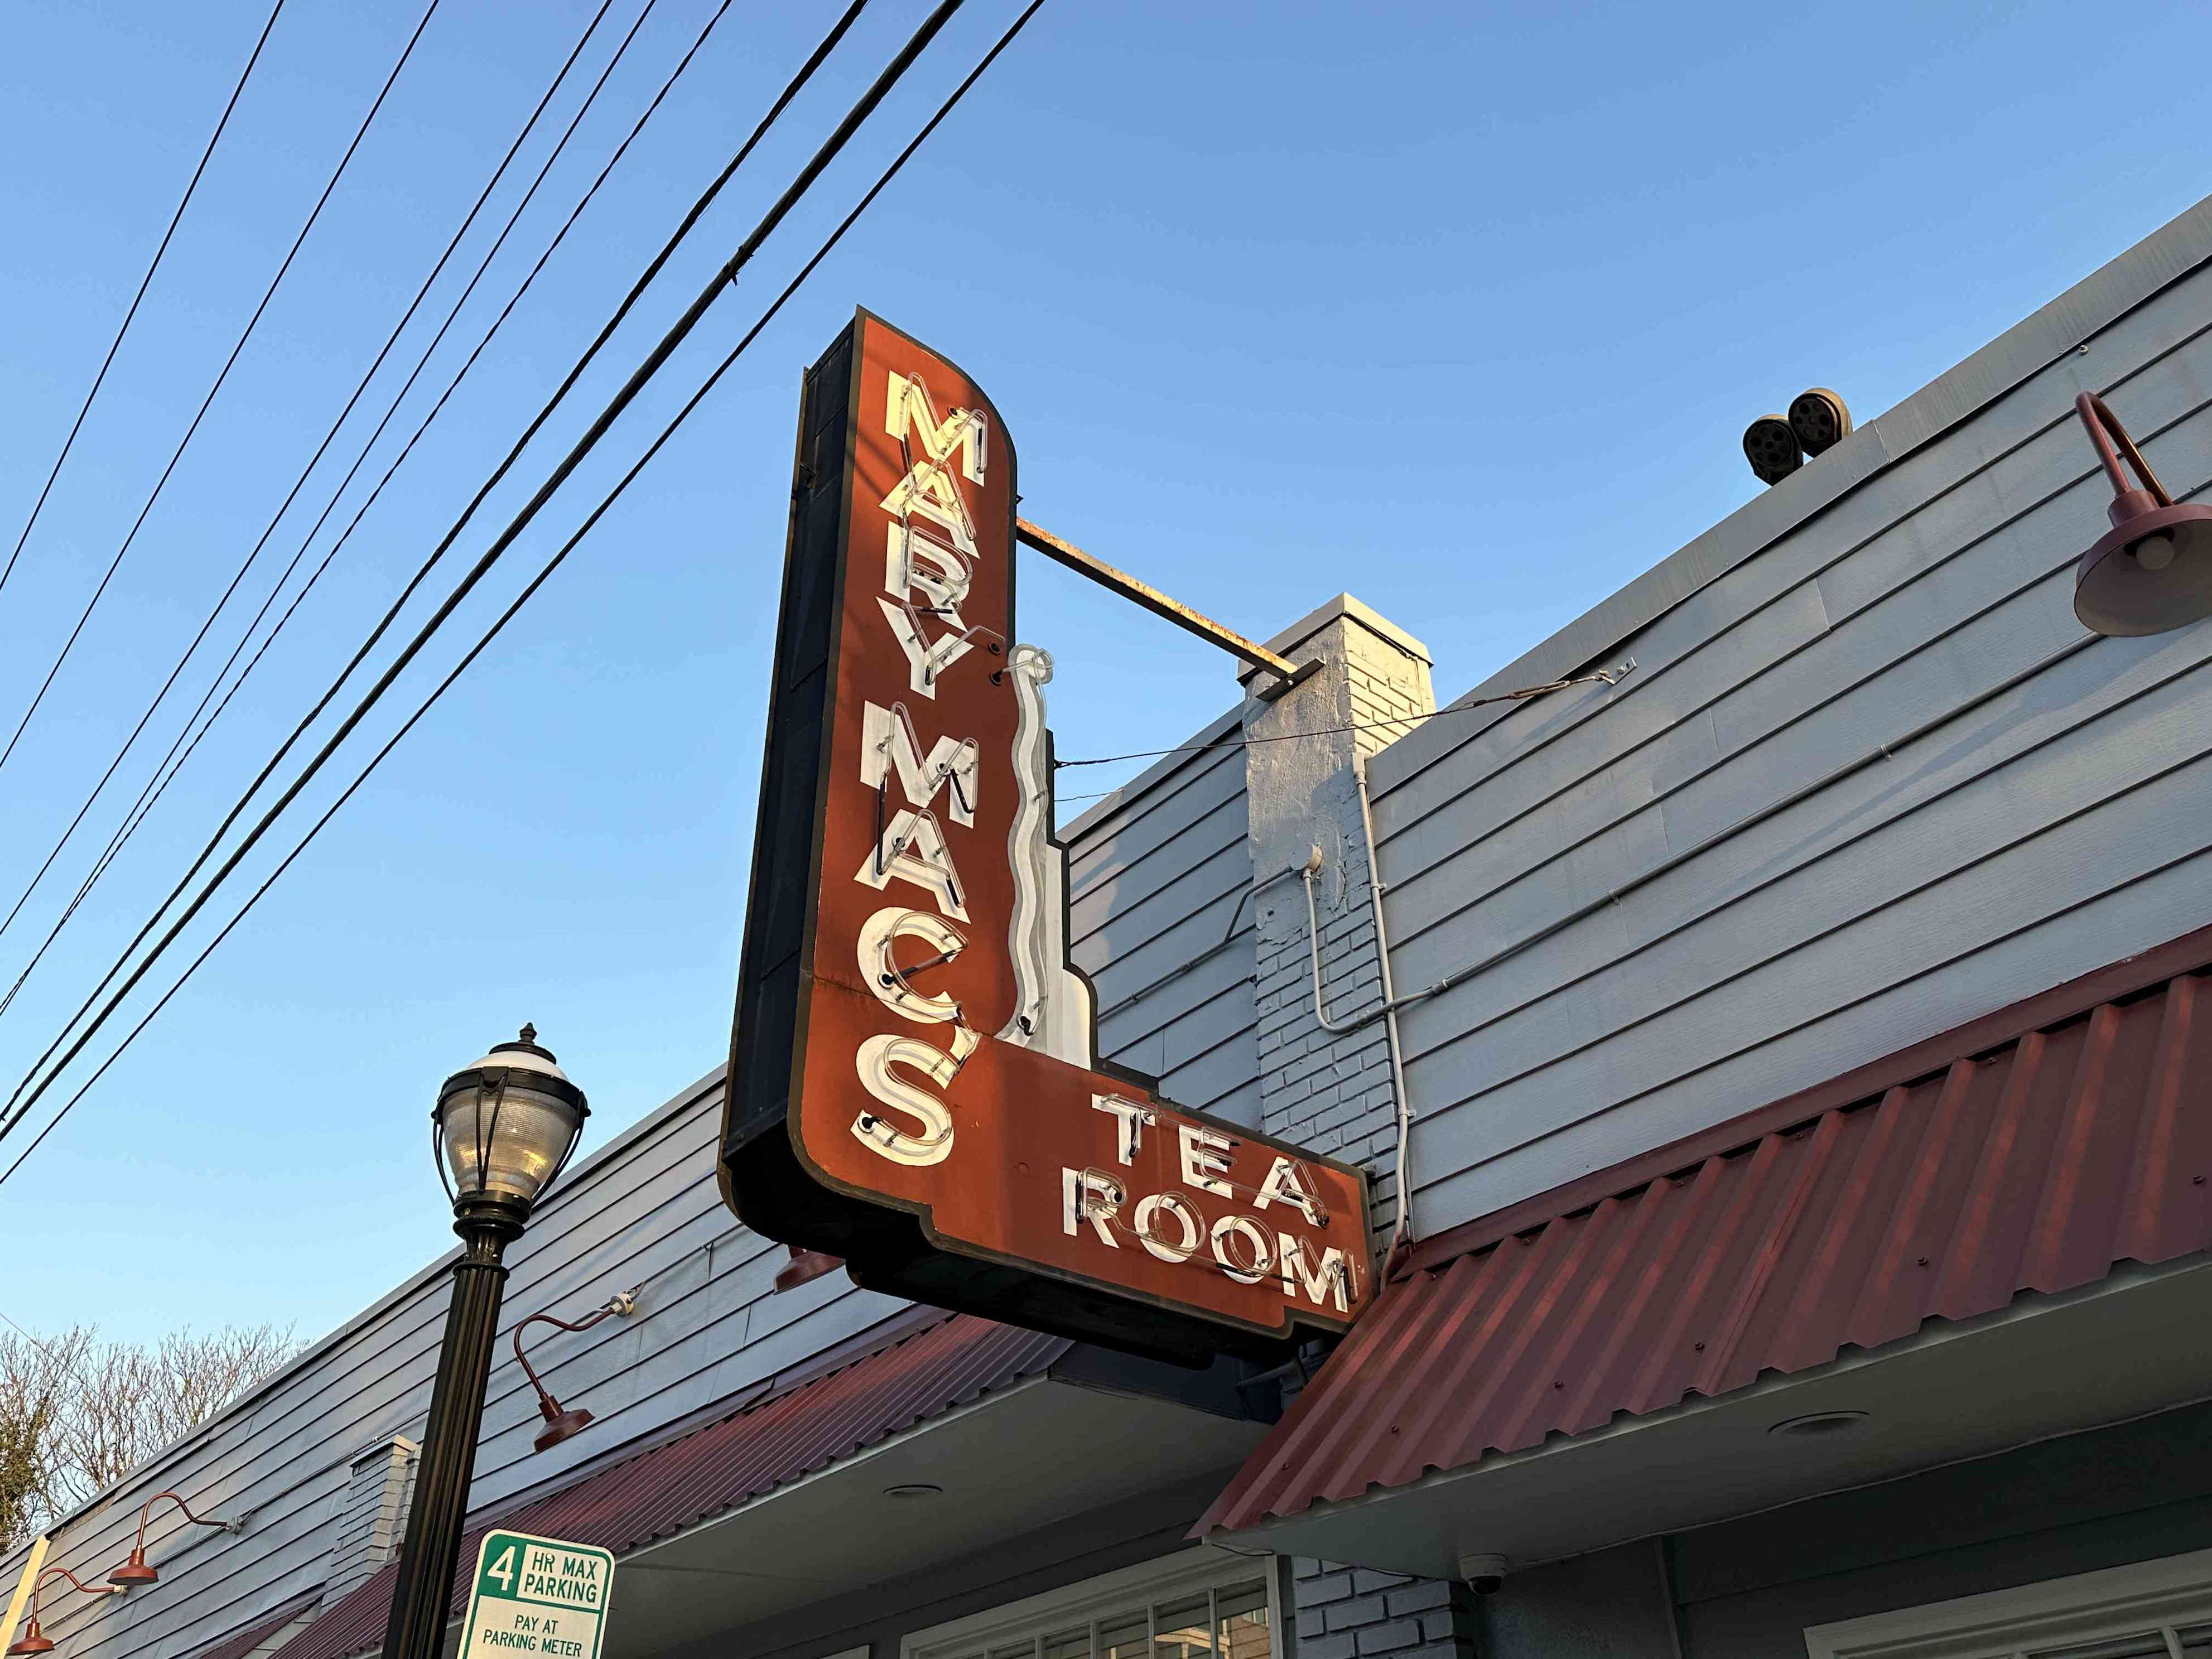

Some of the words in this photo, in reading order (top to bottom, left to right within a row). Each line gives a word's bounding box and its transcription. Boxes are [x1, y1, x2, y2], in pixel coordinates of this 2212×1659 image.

[876, 370, 986, 700] MARY
[1091, 1093, 1329, 1228] TEA
[1062, 1166, 1358, 1313] ROOM
[487, 1545, 516, 1591] 4
[532, 1551, 555, 1573] HR
[562, 1556, 597, 1580] MAX
[524, 1574, 597, 1603] PARKING
[514, 1614, 539, 1632] PAY
[542, 1619, 558, 1634] AT
[483, 1629, 537, 1650] PARKING
[541, 1638, 582, 1657] METER
